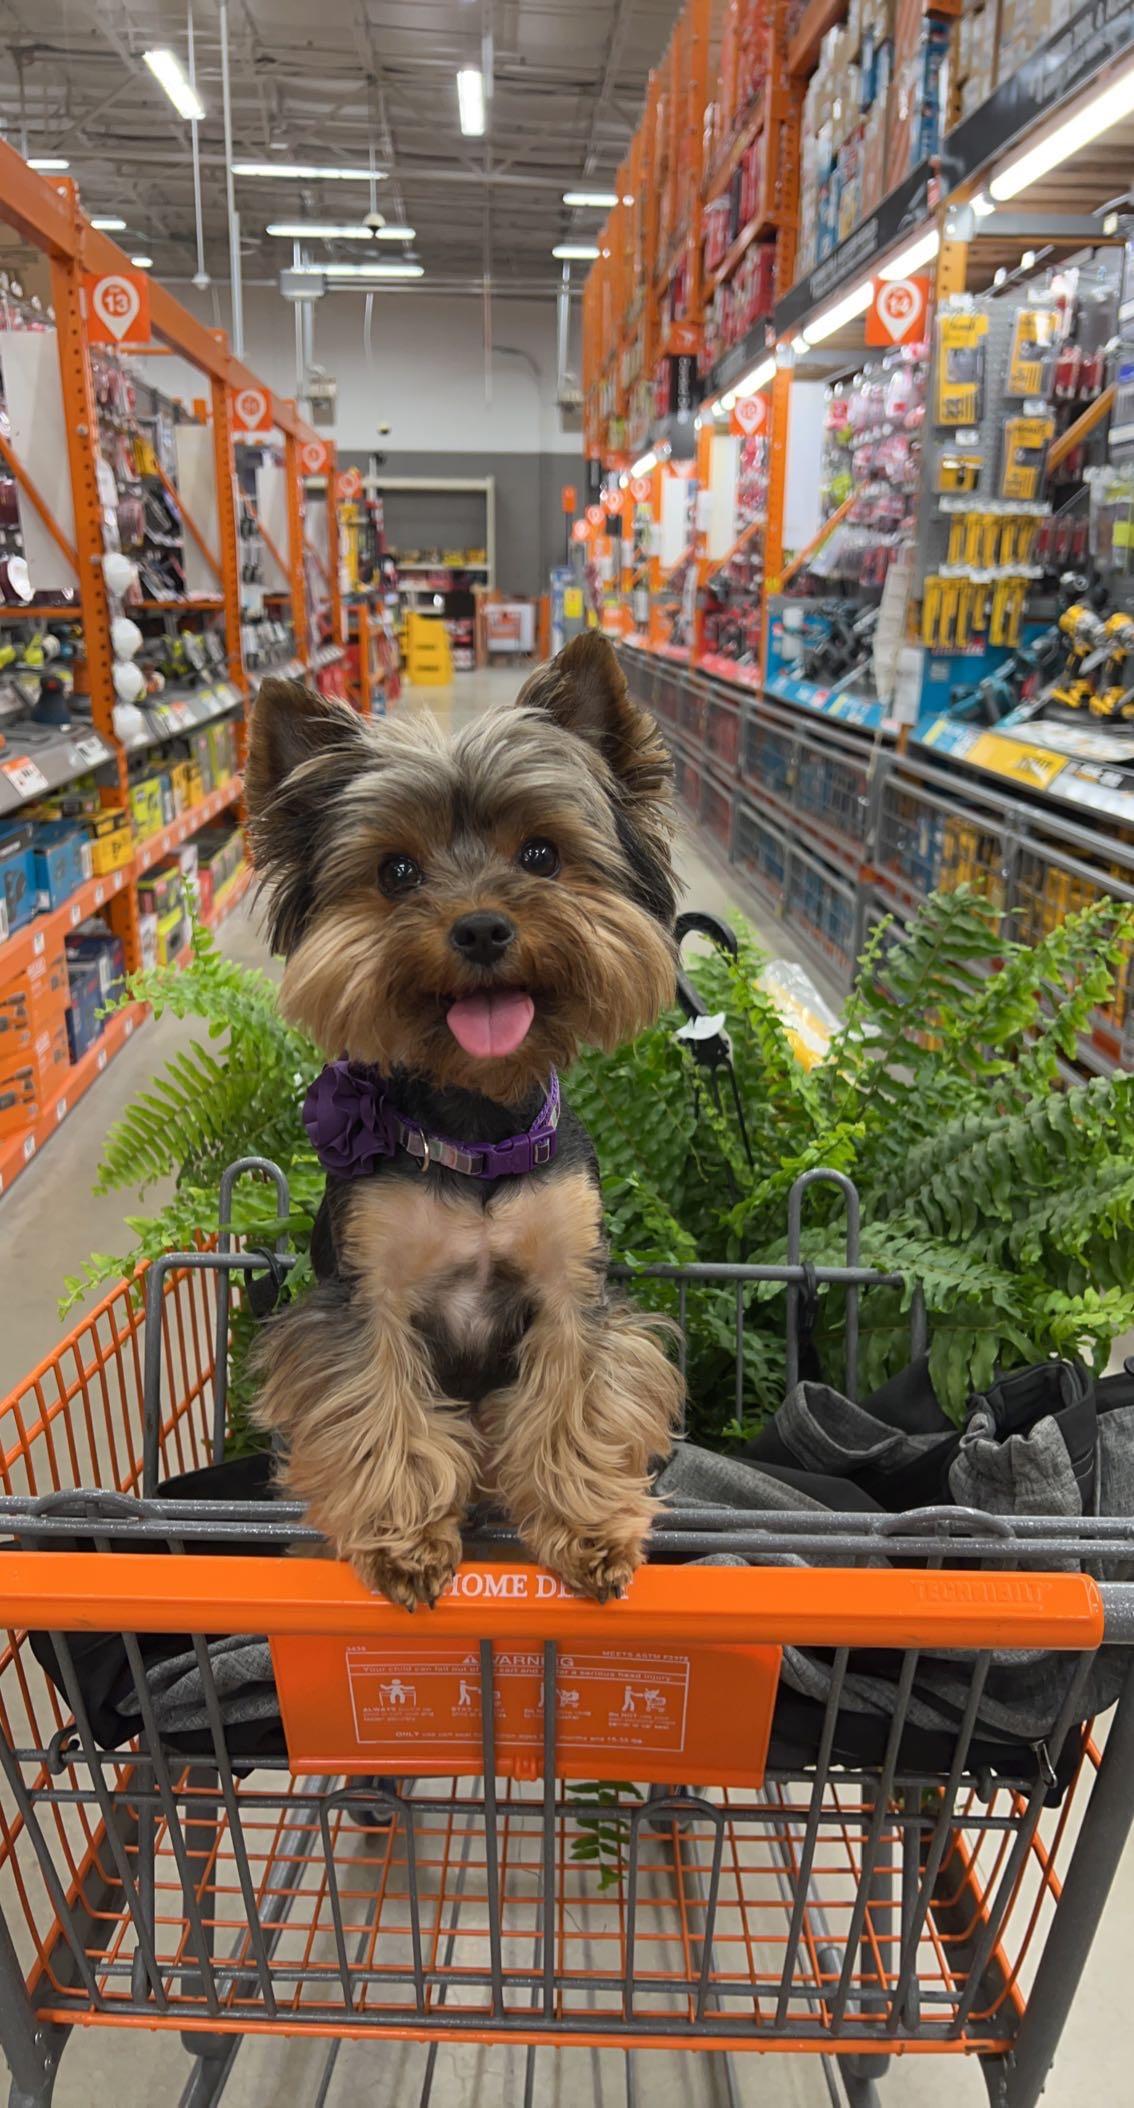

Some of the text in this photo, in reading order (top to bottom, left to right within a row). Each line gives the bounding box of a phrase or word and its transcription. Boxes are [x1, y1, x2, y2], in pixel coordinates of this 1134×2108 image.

[104, 295, 129, 313] 13
[388, 1665, 412, 1673] child
[618, 1671, 642, 1679] head
